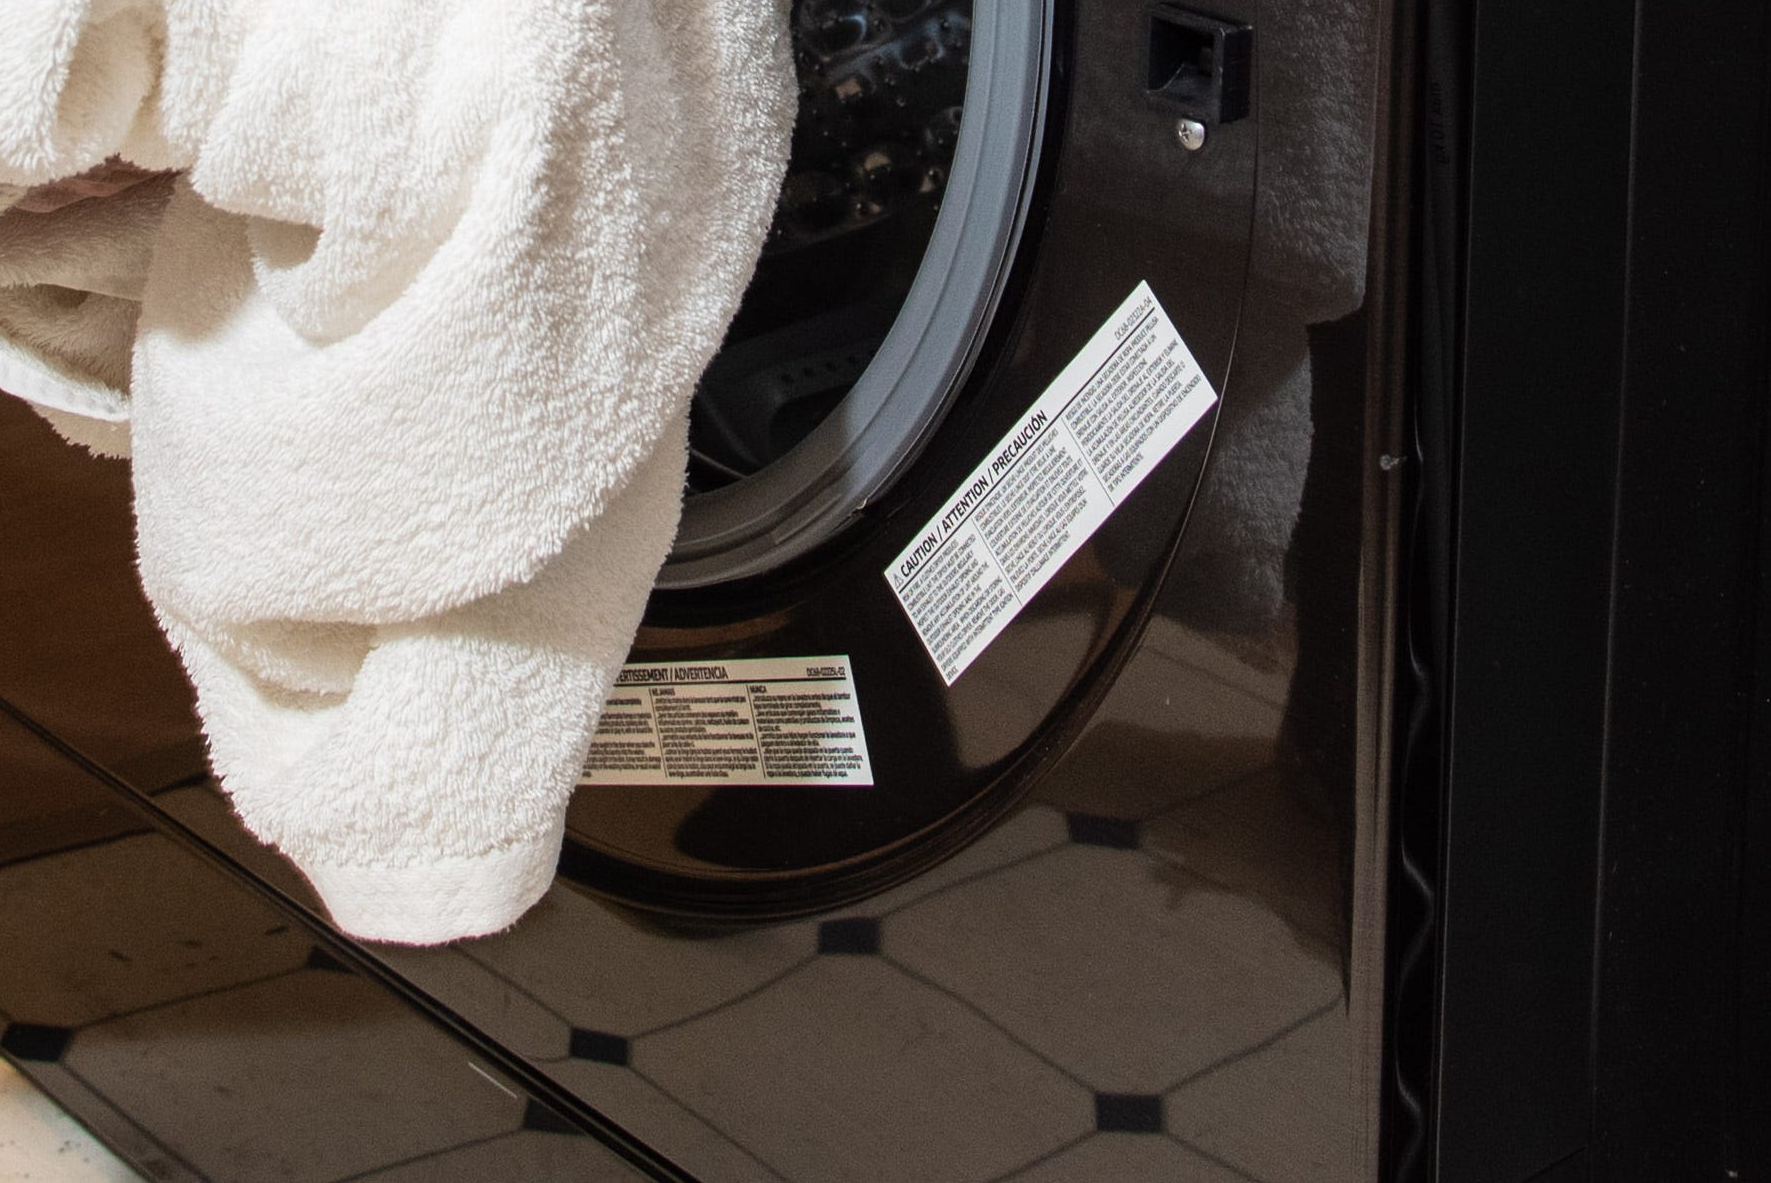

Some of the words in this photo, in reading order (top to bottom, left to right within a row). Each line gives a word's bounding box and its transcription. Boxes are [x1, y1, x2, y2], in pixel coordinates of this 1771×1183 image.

[901, 532, 938, 577] CAUTION
[936, 525, 943, 541] /
[942, 475, 989, 533] ATTENTION
[988, 468, 994, 484] /
[992, 410, 1048, 476] PRECAUCIÓN
[616, 667, 669, 682] ERTISSEMENT
[674, 665, 728, 680] ADVERTENCIA
